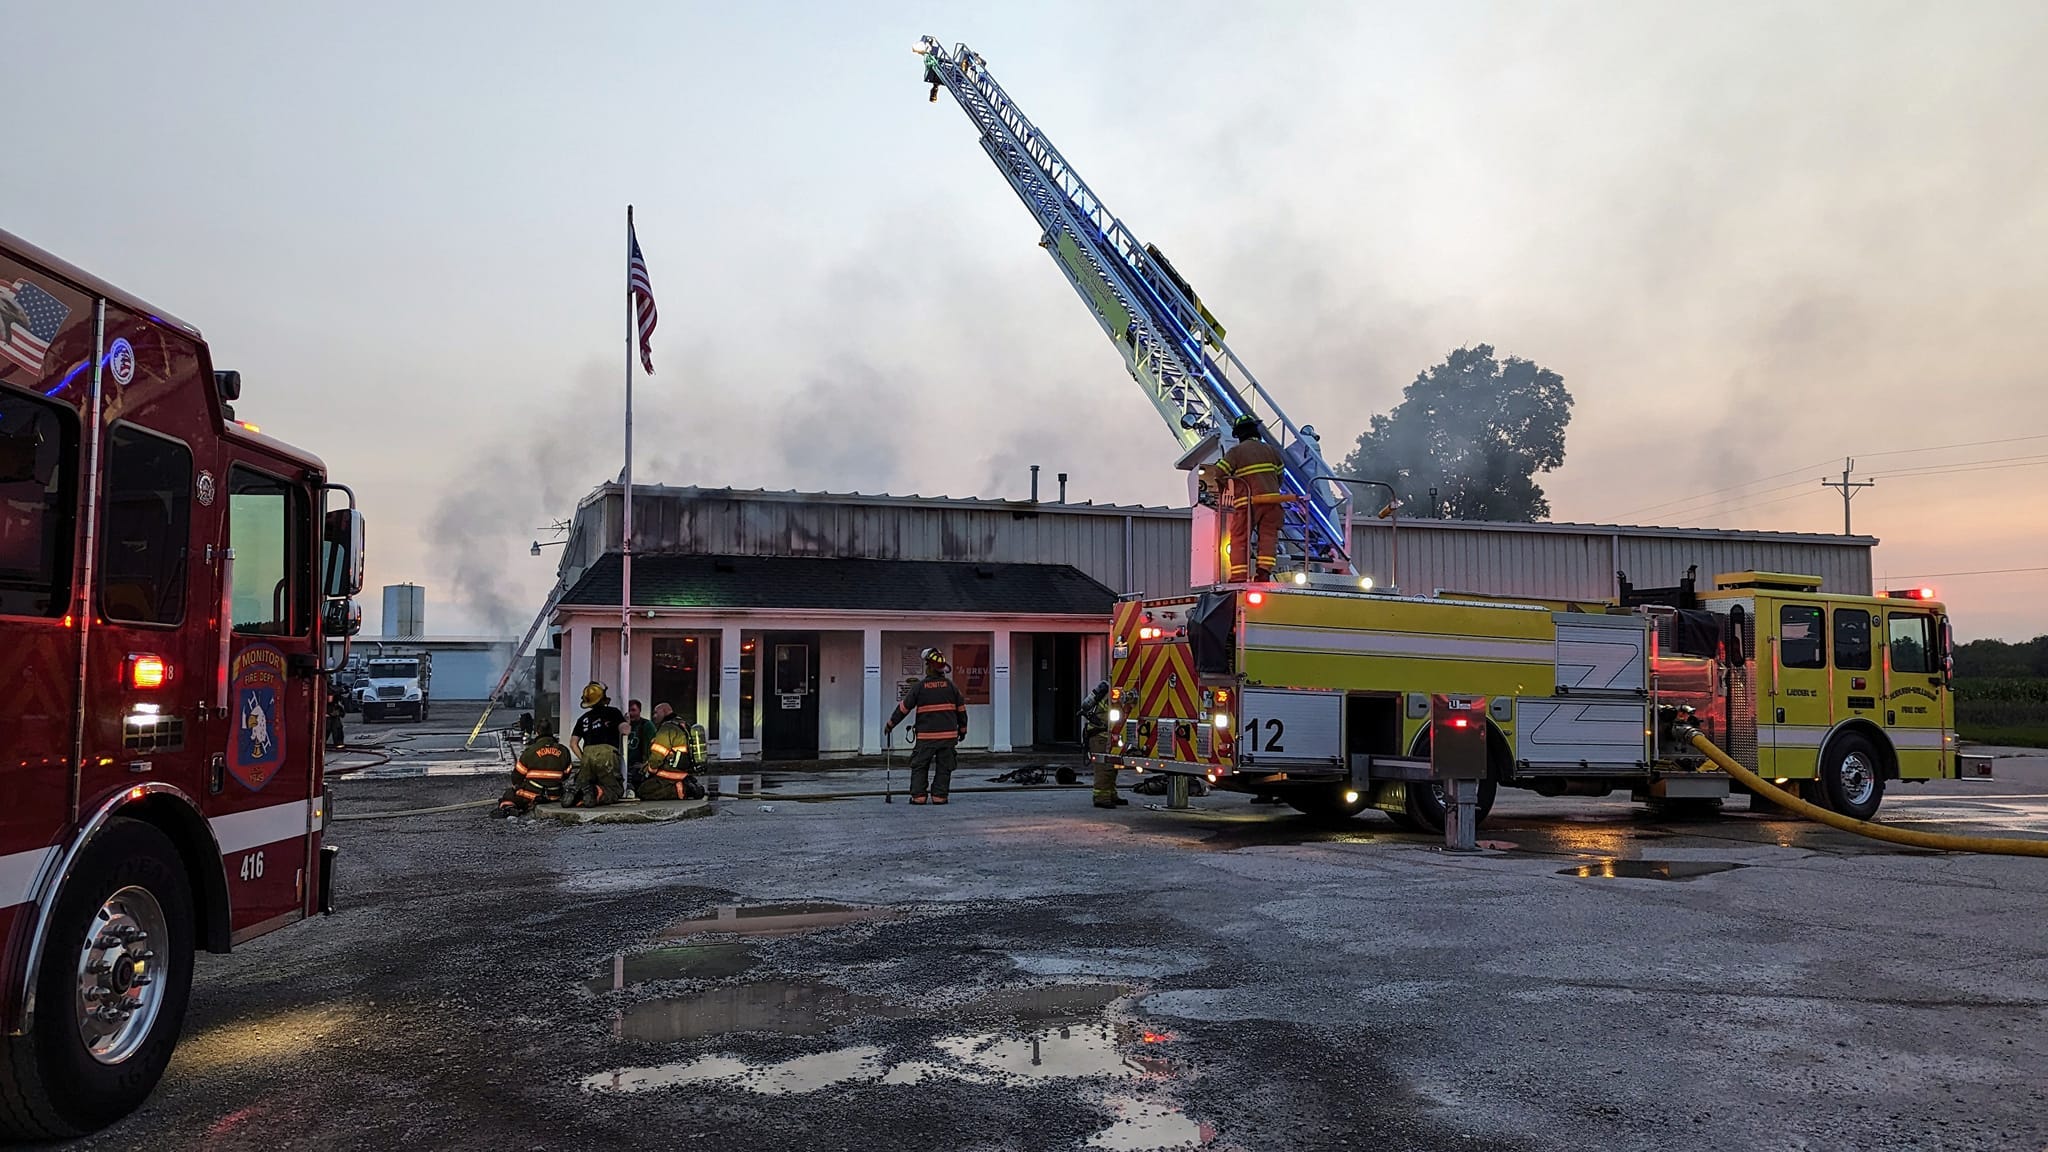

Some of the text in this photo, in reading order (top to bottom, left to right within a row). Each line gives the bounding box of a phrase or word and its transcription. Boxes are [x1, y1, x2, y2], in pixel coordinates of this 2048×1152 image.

[242, 650, 280, 668] MONITOR
[966, 666, 991, 675] BREV
[245, 672, 275, 684] FIRE DEPT
[924, 681, 948, 689] MONITOR
[1245, 718, 1284, 752] 12
[535, 747, 562, 759] MONITOR
[240, 851, 264, 881] 416
